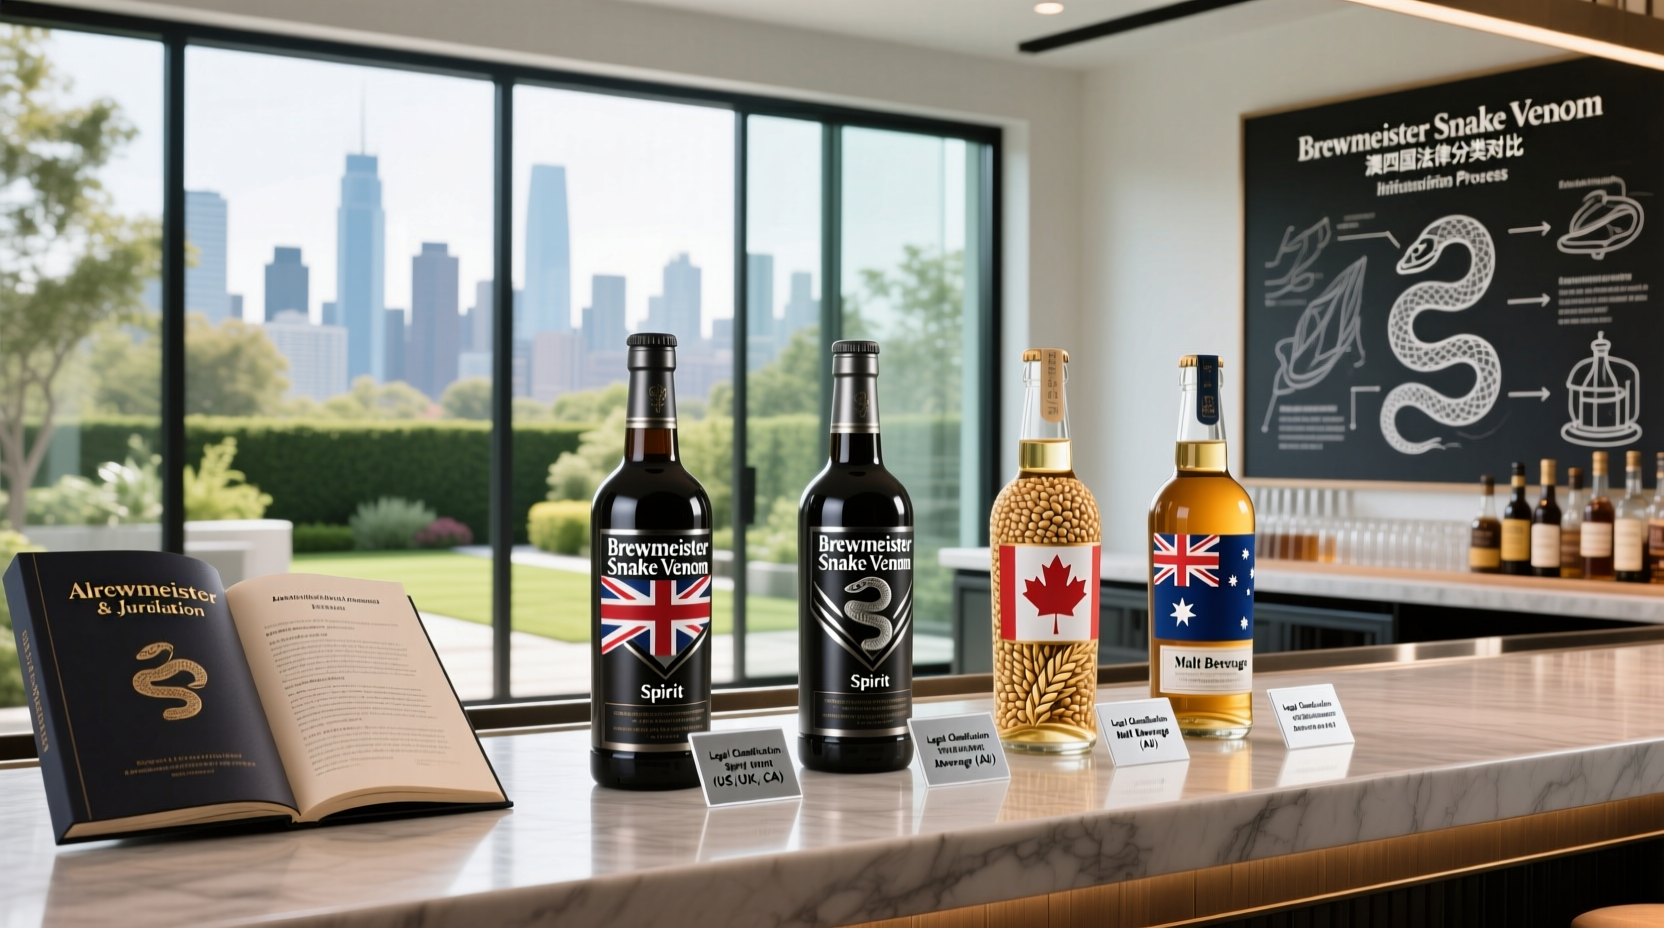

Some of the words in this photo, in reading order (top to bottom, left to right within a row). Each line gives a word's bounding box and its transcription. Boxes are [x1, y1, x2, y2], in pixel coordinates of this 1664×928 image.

[1297, 122, 1430, 162] Brewmeister
[1434, 105, 1507, 140] Snake
[1509, 94, 1604, 129] Venom
[607, 537, 709, 557] Brewmeister
[818, 534, 913, 554] Brewmeister
[607, 557, 659, 576] Snake
[660, 558, 709, 577] Venom
[818, 553, 868, 572] Snake
[97, 601, 112, 615] &
[1174, 656, 1202, 670] Malt
[850, 673, 890, 691] Spirit
[640, 683, 685, 704] Spirit
[763, 770, 784, 784] CA)
